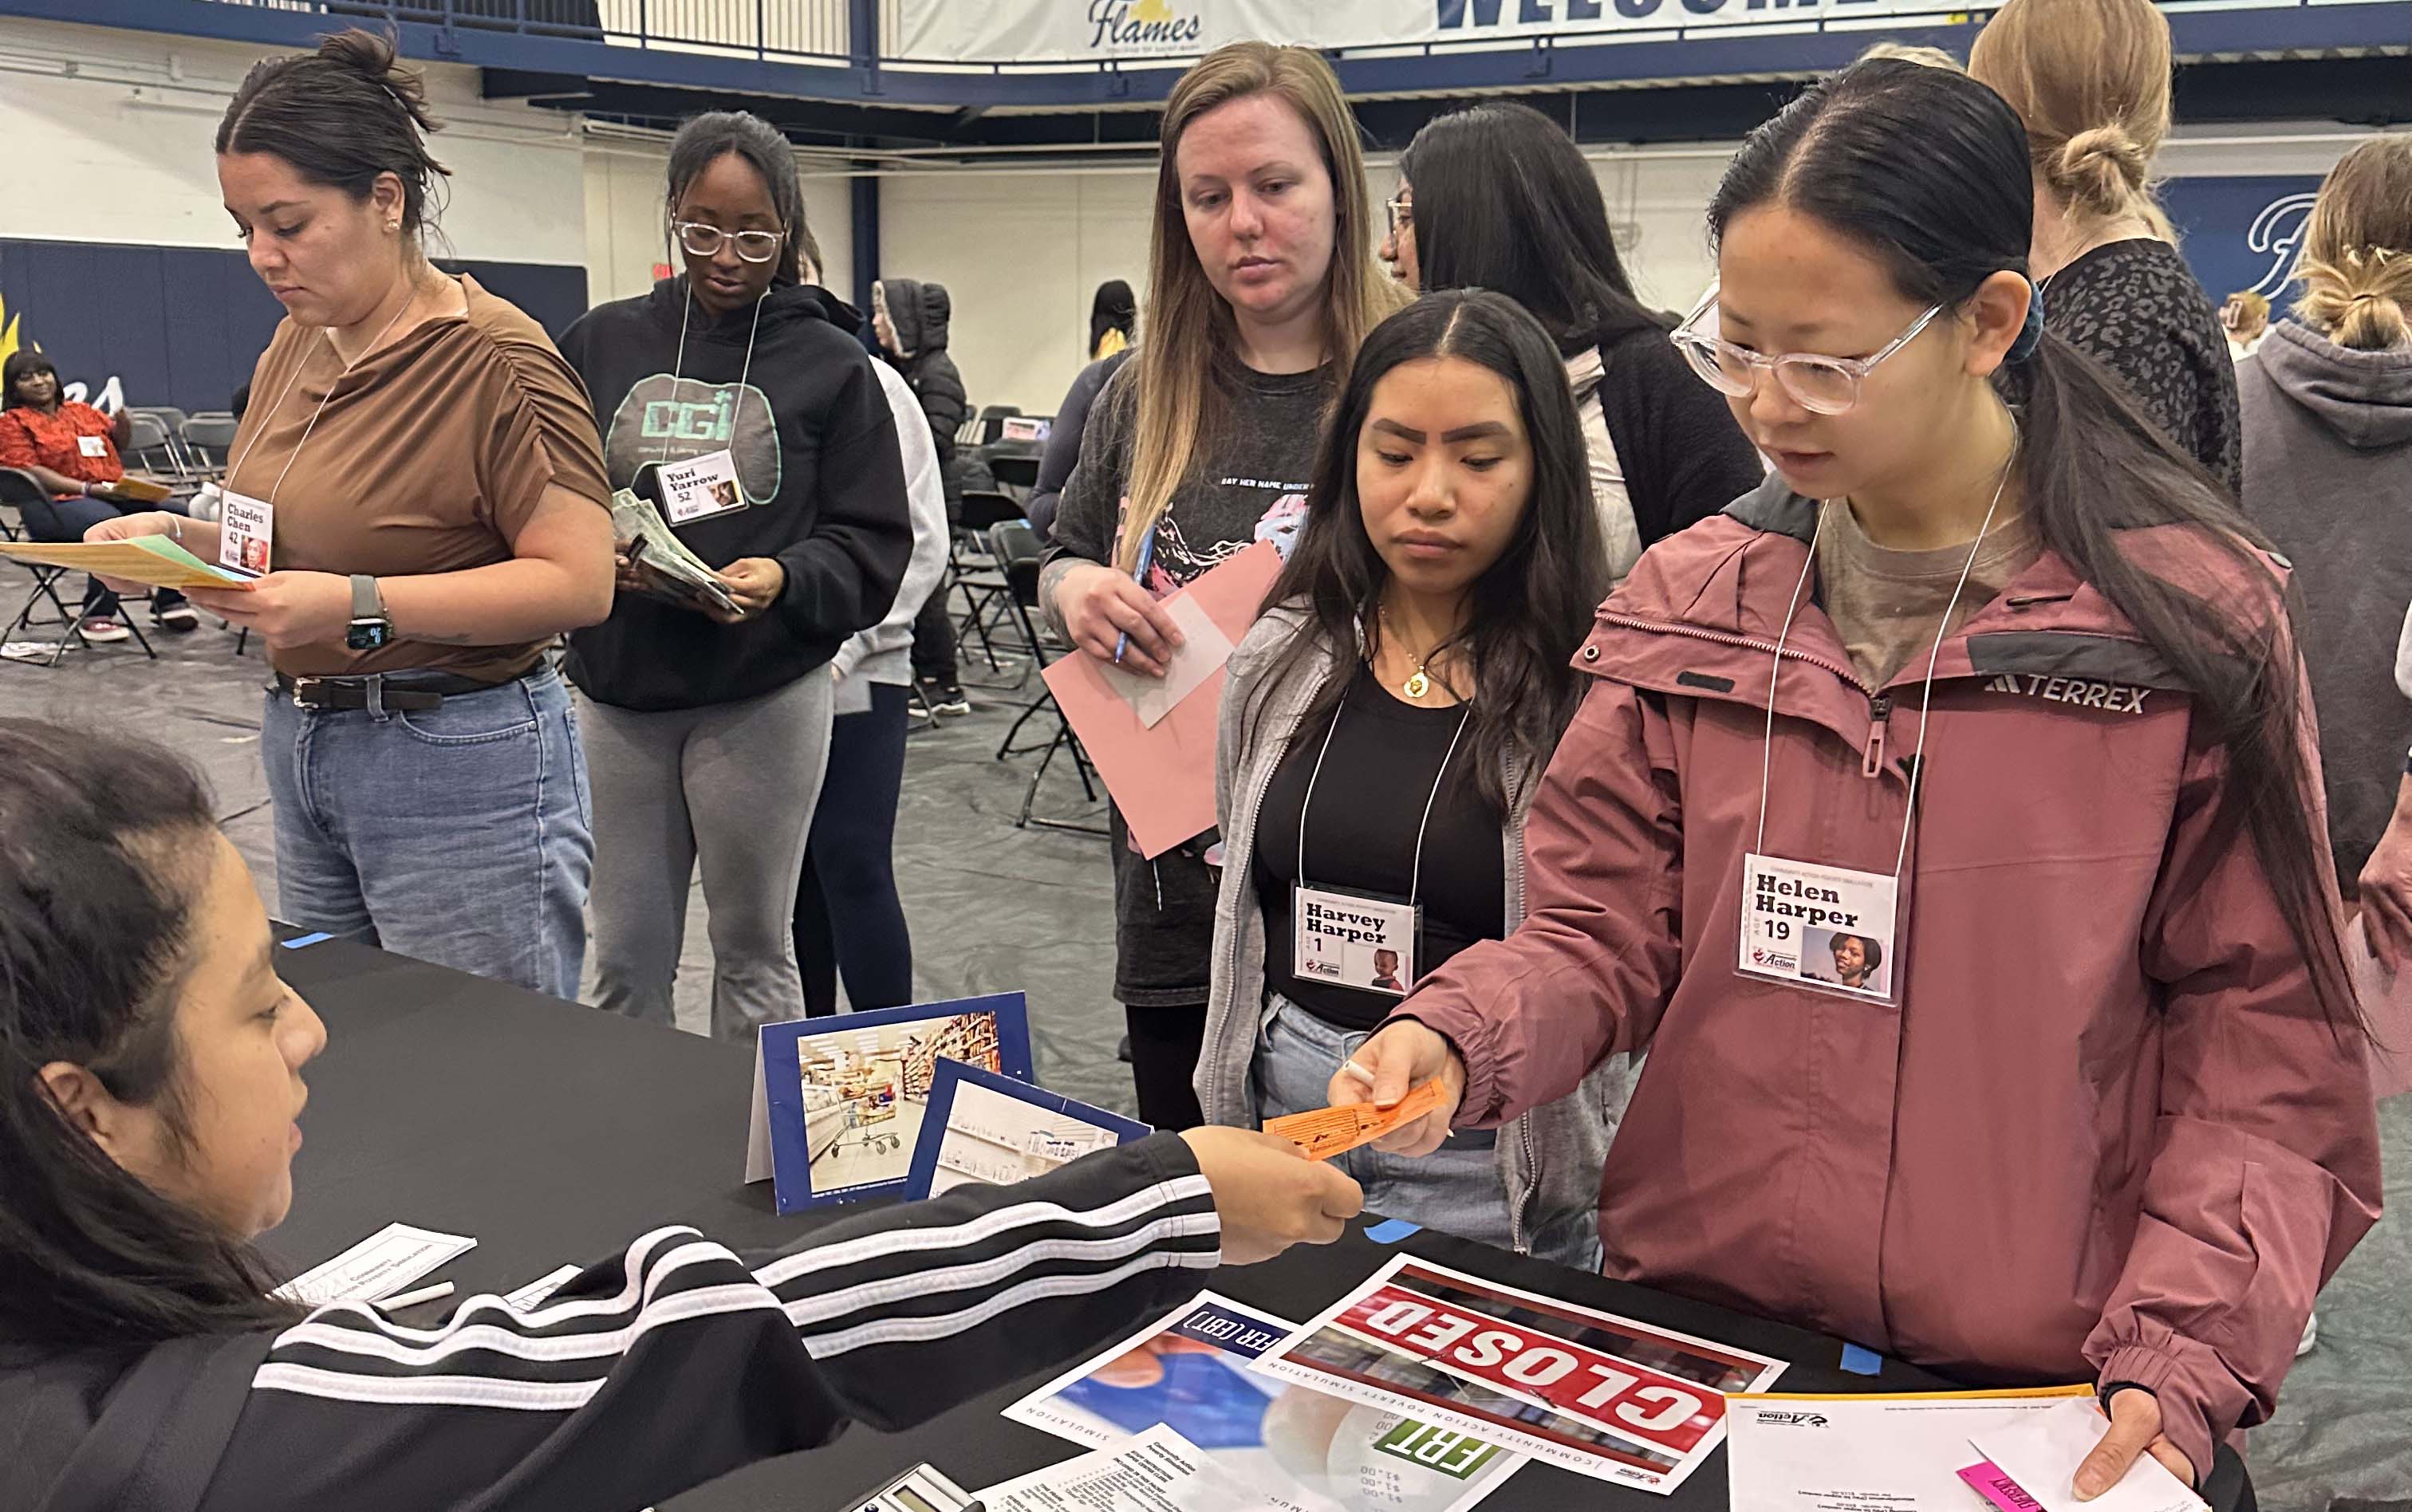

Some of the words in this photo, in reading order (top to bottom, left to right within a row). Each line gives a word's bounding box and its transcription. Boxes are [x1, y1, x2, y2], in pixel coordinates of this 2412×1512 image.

[1089, 0, 1201, 48] Flames
[666, 468, 696, 482] Yuri
[669, 473, 719, 492] Yarrow
[678, 492, 691, 503] 52
[227, 502, 264, 523] Charles
[227, 516, 250, 533] Chen
[229, 531, 238, 544] 42
[2028, 674, 2151, 715] TERREX
[1757, 873, 1839, 904] Helen
[1306, 903, 1385, 931] Harvey
[1756, 894, 1858, 927] Harper
[1306, 918, 1386, 944] Harper
[1765, 919, 1790, 940] 19
[1314, 938, 1322, 952] 1
[1764, 954, 1795, 970] Action
[1183, 1310, 1239, 1341] (EBT)
[1268, 1362, 1354, 1392] SIMULATION
[1366, 1300, 1702, 1432] CLOSED
[1361, 1390, 1433, 1414] POVERTY
[1026, 1406, 1109, 1441] SIMULATION
[1433, 1412, 1489, 1432] ACTION
[1759, 1414, 1810, 1423] Action
[1497, 1431, 1593, 1469] COMMUNITY
